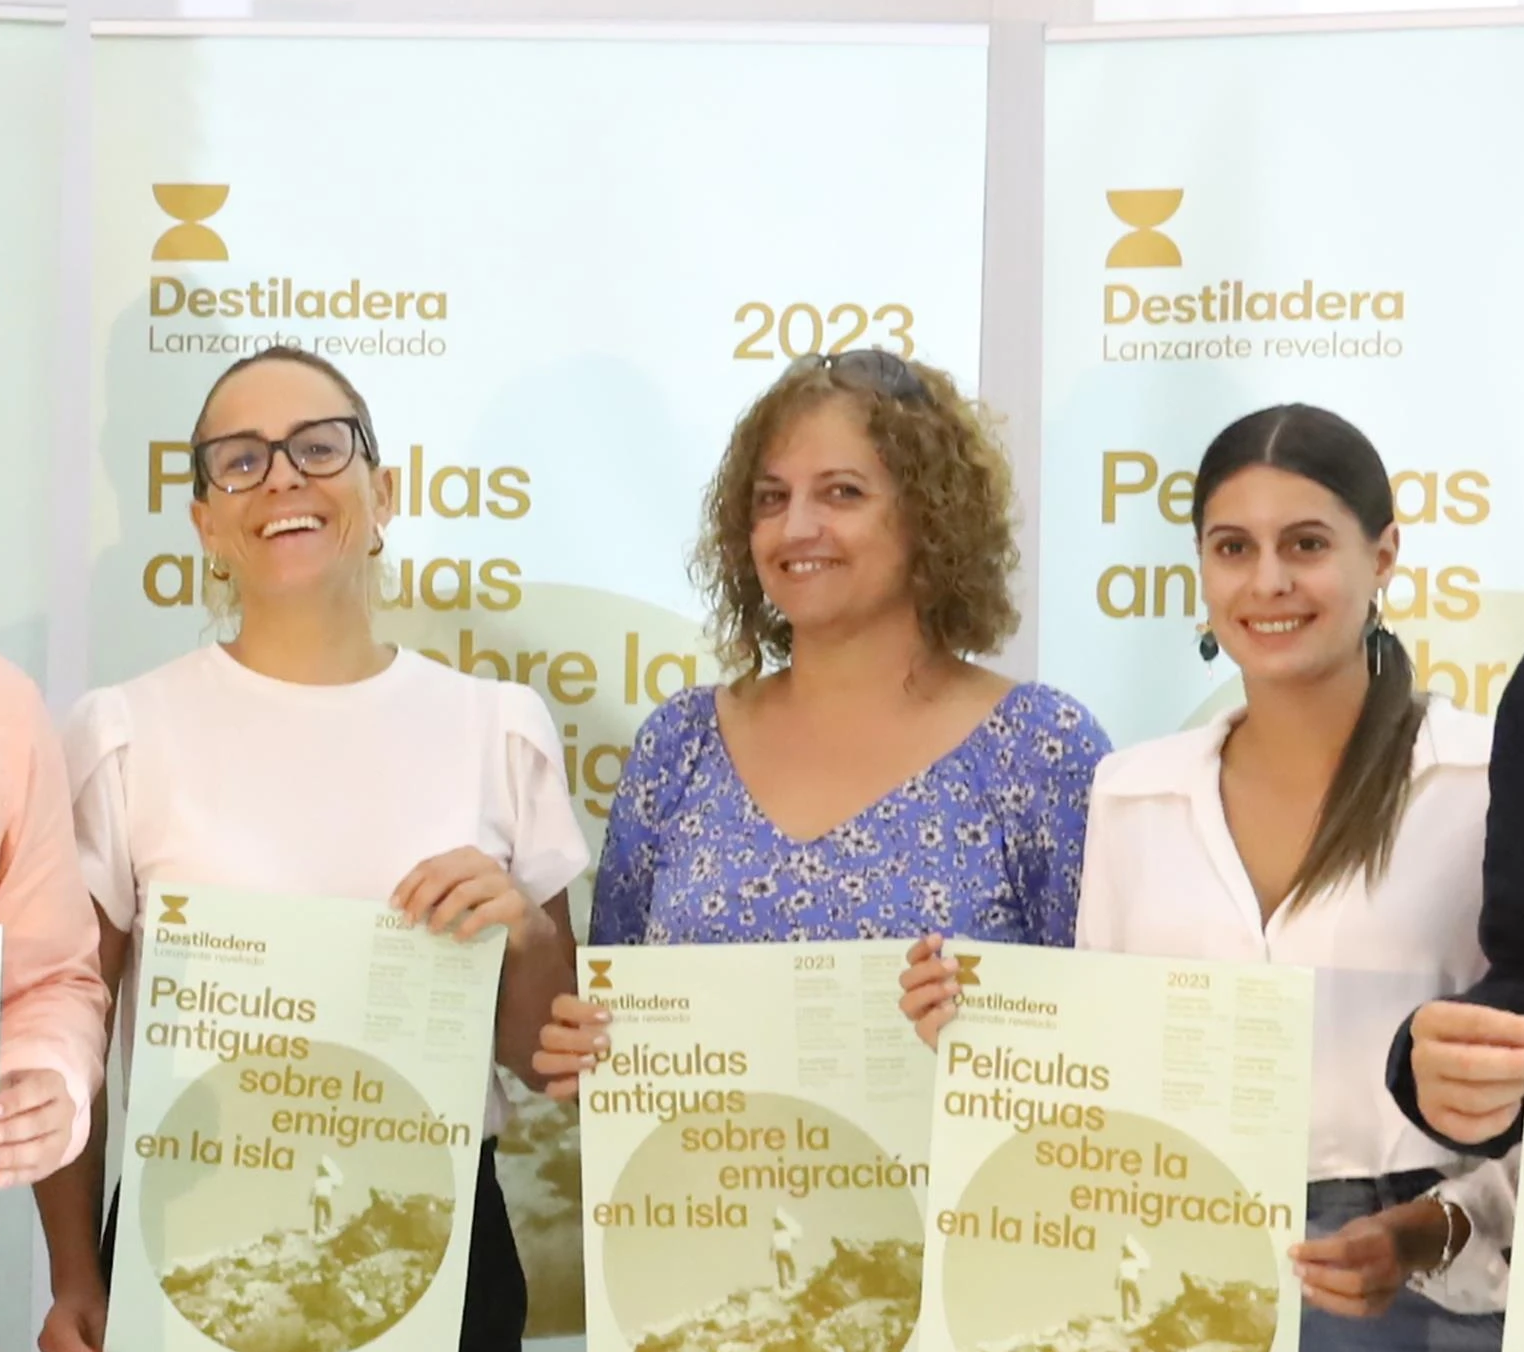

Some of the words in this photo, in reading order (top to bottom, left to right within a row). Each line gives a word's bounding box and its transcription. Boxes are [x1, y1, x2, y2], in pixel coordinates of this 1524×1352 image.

[149, 275, 448, 321] Destiladera
[1104, 279, 1406, 326] Destiladera
[149, 325, 302, 354] Lanzarote
[314, 329, 447, 358] revelado
[732, 301, 916, 360] 2023
[1102, 333, 1253, 363] Lanzarote
[1264, 330, 1404, 361] revelado
[624, 631, 698, 706] la
[155, 927, 267, 954] Destiladera
[793, 954, 836, 971] 2023
[149, 975, 317, 1024] Películas
[1166, 970, 1211, 991] 2023
[953, 991, 1058, 1017] Destiladera
[145, 1019, 311, 1064] antiguas
[238, 1065, 343, 1101] sobre
[352, 1070, 385, 1105] la
[948, 1041, 1111, 1093] Películas
[589, 1082, 747, 1124] antiguas
[943, 1087, 1106, 1134] antiguas
[270, 1105, 471, 1148] emigración
[681, 1118, 786, 1152] sobre
[796, 1118, 830, 1151] la
[134, 1133, 180, 1162] en
[189, 1130, 223, 1166] la
[233, 1133, 295, 1172] isla
[1034, 1134, 1143, 1177] sobre
[1153, 1142, 1189, 1181] la
[718, 1153, 929, 1199] emigración
[592, 1200, 636, 1228] en
[645, 1194, 675, 1229] la
[685, 1194, 749, 1229] isla
[1069, 1181, 1293, 1231] emigración
[936, 1207, 980, 1239] en
[990, 1205, 1023, 1244] la
[1032, 1211, 1097, 1252] isla
